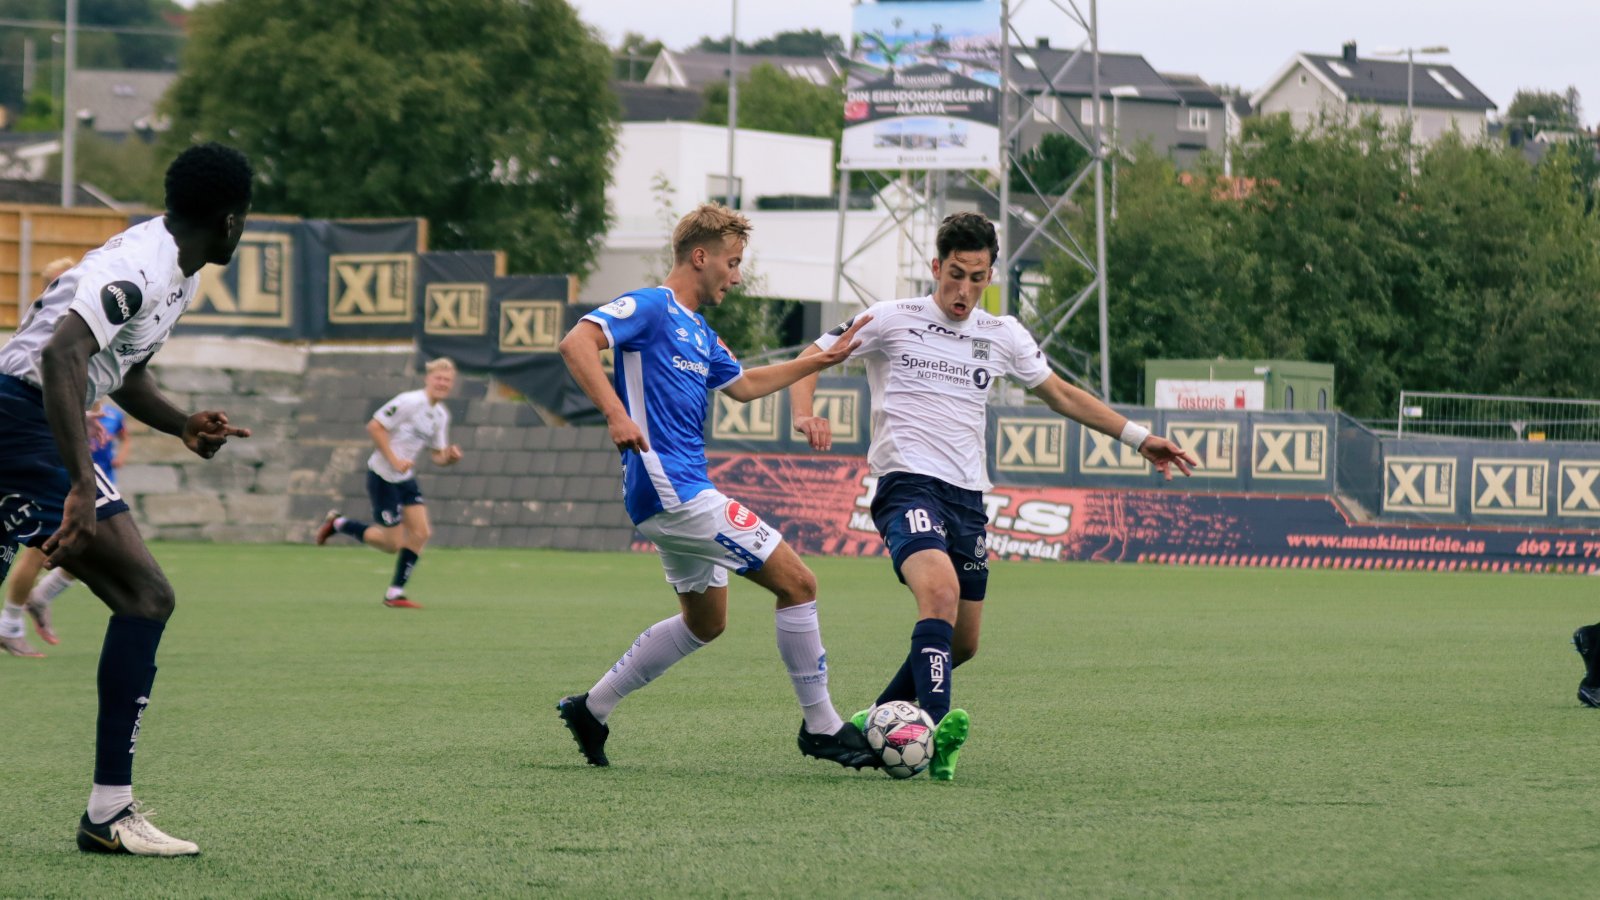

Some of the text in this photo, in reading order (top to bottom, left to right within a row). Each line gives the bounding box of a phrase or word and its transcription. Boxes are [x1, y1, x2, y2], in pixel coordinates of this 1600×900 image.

[847, 91, 869, 102] DIN
[872, 90, 985, 103] EIENDOMSMEGLER
[896, 103, 945, 114] ALANYA
[107, 284, 131, 320] altibox
[335, 262, 407, 314] XL
[430, 291, 480, 327] XL
[504, 308, 555, 346] XL
[901, 354, 970, 377] SpareBank
[917, 371, 970, 387] NORDMØRE
[718, 396, 772, 433] XL
[1177, 392, 1226, 409] fastpris
[1001, 425, 1058, 465] XL
[1085, 428, 1144, 467] XL
[1172, 430, 1231, 470] XL
[1257, 431, 1320, 472] XL
[1388, 464, 1449, 505] XL
[1476, 467, 1542, 508] XL
[755, 526, 770, 542] 24
[905, 508, 932, 533] 16
[1287, 534, 1486, 554] www.maskinutleie.as
[1516, 539, 1551, 555] 469
[1555, 541, 1577, 556] 71
[930, 655, 944, 693] NEAS
